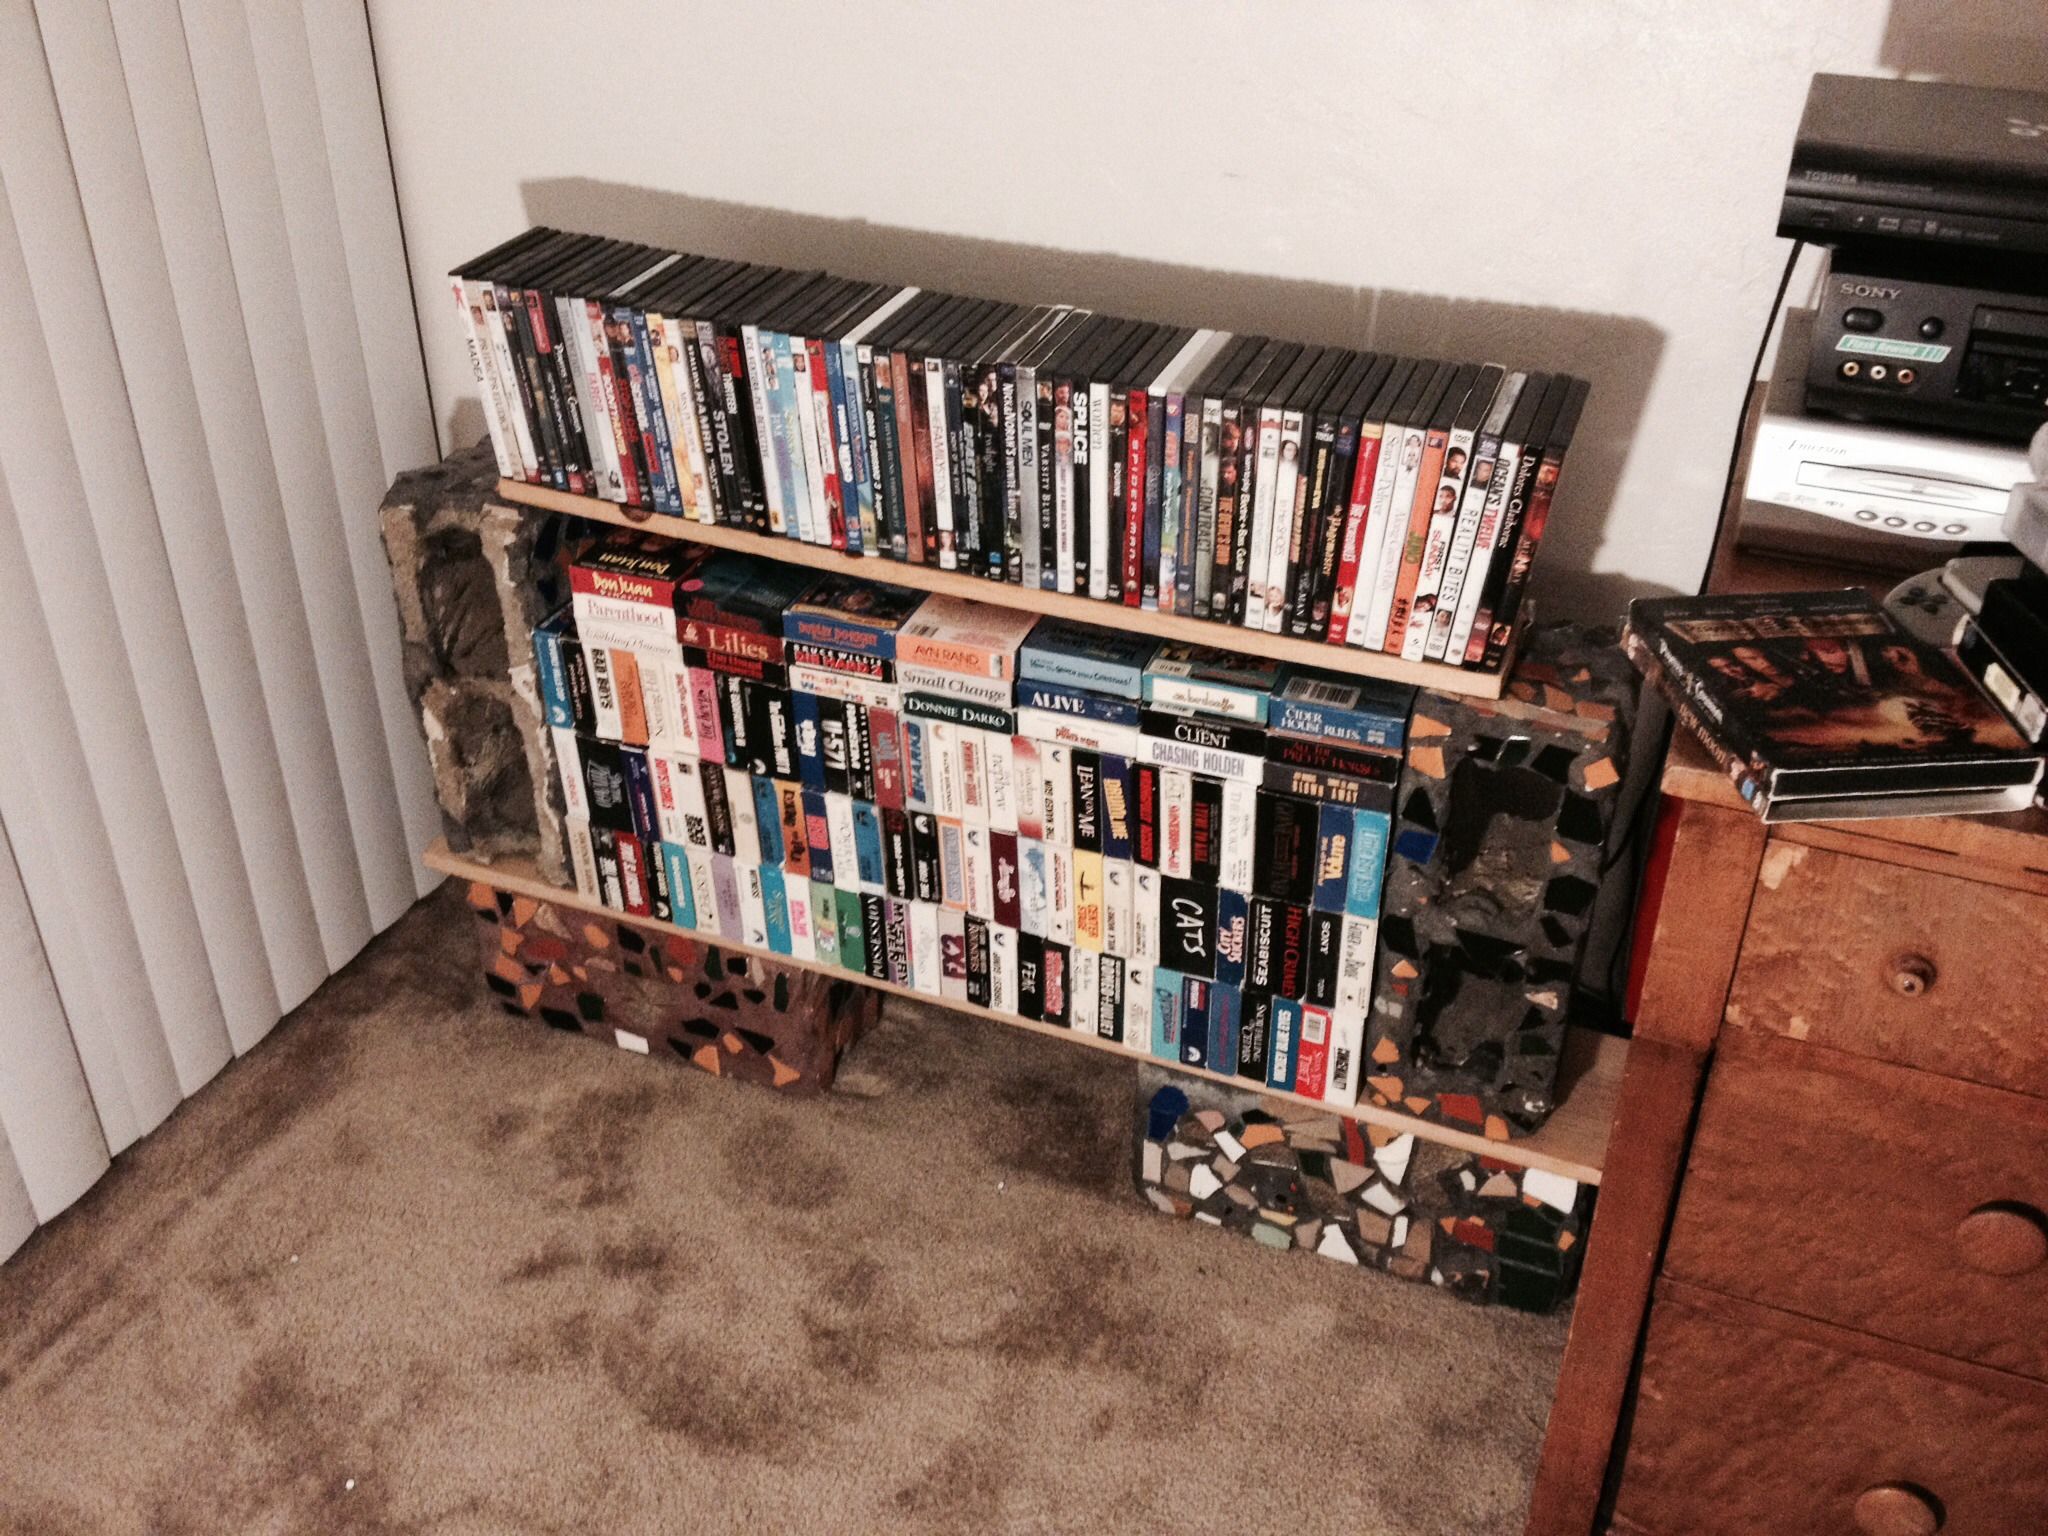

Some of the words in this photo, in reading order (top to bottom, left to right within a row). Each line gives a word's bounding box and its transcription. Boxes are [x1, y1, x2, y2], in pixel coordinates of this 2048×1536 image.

[1804, 170, 1858, 185] TOSHIBA
[1839, 283, 1901, 299] SONY
[464, 337, 484, 383] MADEA
[745, 335, 754, 351] ACE
[586, 371, 604, 413] FARGO
[601, 373, 619, 416] BOUNTY
[629, 382, 649, 429] SCHOOL
[721, 372, 737, 415] THIRTEEN
[694, 390, 714, 454] RAMBO
[865, 409, 876, 438] GRAN
[1021, 399, 1032, 436] SOUL
[1071, 391, 1089, 465] SPLICE
[712, 408, 734, 476] STOLEN
[868, 438, 879, 480] TURISMO
[932, 424, 945, 468] FAMILY
[983, 433, 996, 473] twilight
[1022, 436, 1033, 467] MEN
[1381, 435, 1398, 469] Stand
[837, 442, 853, 483] NEMO
[1039, 442, 1050, 490] VARSITY
[1112, 461, 1122, 497] BOURNE
[1512, 454, 1535, 497] Dolores
[872, 480, 881, 490] 3
[1372, 477, 1391, 516] Deliver
[1486, 458, 1511, 506] OCEAN'S
[1040, 492, 1052, 529] BLUES
[1194, 486, 1217, 554] CONTRACT
[1475, 507, 1498, 550] TWELVE
[1498, 498, 1523, 549] Claiborne
[1317, 516, 1342, 576] Pagemaster
[1451, 508, 1477, 562] REALITY
[1432, 540, 1446, 571] FIRST
[591, 571, 619, 593] Don
[617, 575, 654, 598] Juan
[1441, 567, 1462, 602] BITES
[585, 596, 665, 629] Parenthood
[591, 647, 607, 674] BAD
[707, 627, 769, 660] Lilies
[793, 643, 834, 657] BRUCE
[838, 651, 881, 666] WILLIS
[915, 645, 940, 659] AYN
[941, 648, 979, 666] RAND
[822, 655, 869, 676] HARD
[869, 664, 883, 678] 2
[596, 676, 614, 710] BOYS
[903, 669, 946, 690] Small
[947, 677, 1006, 704] Change
[1032, 689, 1085, 716] ALIVE
[908, 696, 959, 720] DONNIE
[961, 706, 1005, 729] DARKO
[1281, 716, 1322, 734] HOUSE
[1323, 724, 1361, 741] RULES
[1285, 707, 1322, 723] CIDER
[820, 717, 846, 771] U-571
[845, 702, 860, 769] RANSOM
[1174, 723, 1230, 750] CLIENT
[1151, 741, 1198, 768] CHASING
[1202, 751, 1245, 777] HOLDEN
[1043, 778, 1052, 796] GUN
[1076, 764, 1093, 801] LEAN
[1045, 796, 1053, 822] NAKED
[1078, 812, 1094, 839] ME
[1045, 824, 1054, 840] THE
[1357, 828, 1378, 857] Little
[1326, 831, 1346, 881] Volume
[1354, 855, 1373, 880] Boy
[866, 893, 884, 978] POSSESSION
[1087, 903, 1098, 940] CENTER
[1107, 905, 1115, 931] MONEY
[1169, 895, 1208, 958] CATS
[1284, 905, 1300, 947] HIGH
[1345, 919, 1367, 948] FATHER
[885, 920, 897, 964] MEN
[892, 901, 907, 983] MYSTERY
[967, 923, 980, 974] ROUNDERS
[1107, 932, 1116, 951] MILK
[1217, 925, 1234, 956] CITY
[1225, 912, 1245, 965] SLICKERS
[1255, 903, 1273, 986] SEABISCUIT
[1318, 919, 1331, 955] SONY
[1280, 947, 1299, 998] CRIMES
